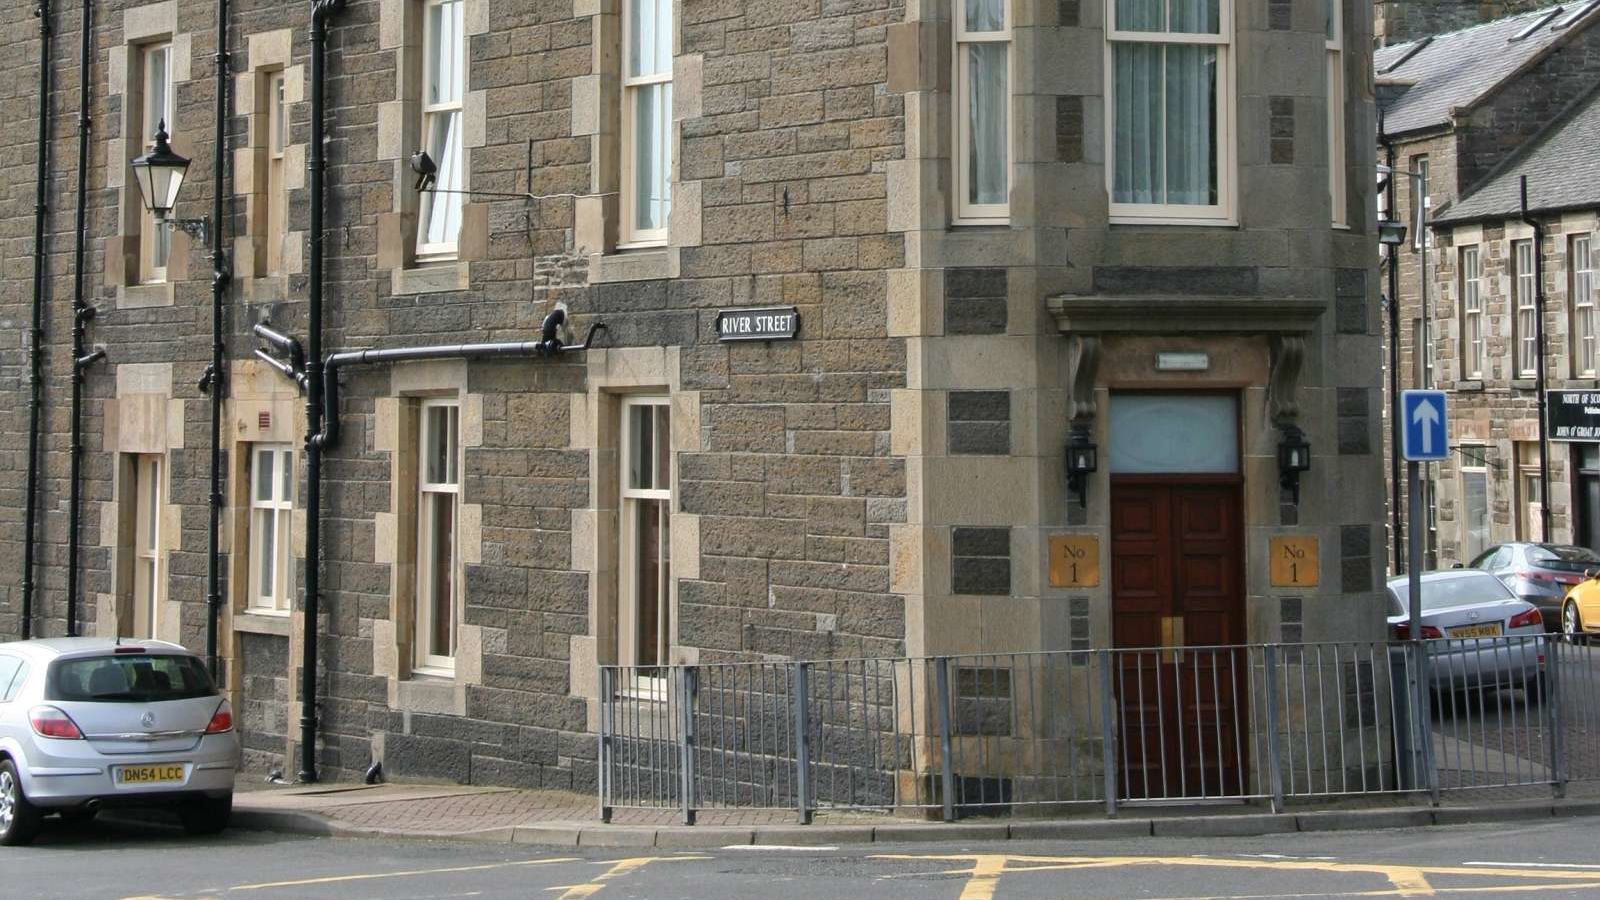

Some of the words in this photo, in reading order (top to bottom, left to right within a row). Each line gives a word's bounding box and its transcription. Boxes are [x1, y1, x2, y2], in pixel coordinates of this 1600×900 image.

[722, 317, 751, 334] RIVER
[756, 315, 792, 332] STREET
[1562, 393, 1579, 404] NORTH
[1581, 393, 1589, 404] OF
[1556, 426, 1569, 436] JOHN
[1063, 544, 1086, 559] No
[1283, 544, 1304, 559] No
[1069, 562, 1080, 583] 1
[1289, 562, 1299, 583] 1
[124, 767, 156, 781] DN54
[159, 767, 184, 780] LCC
